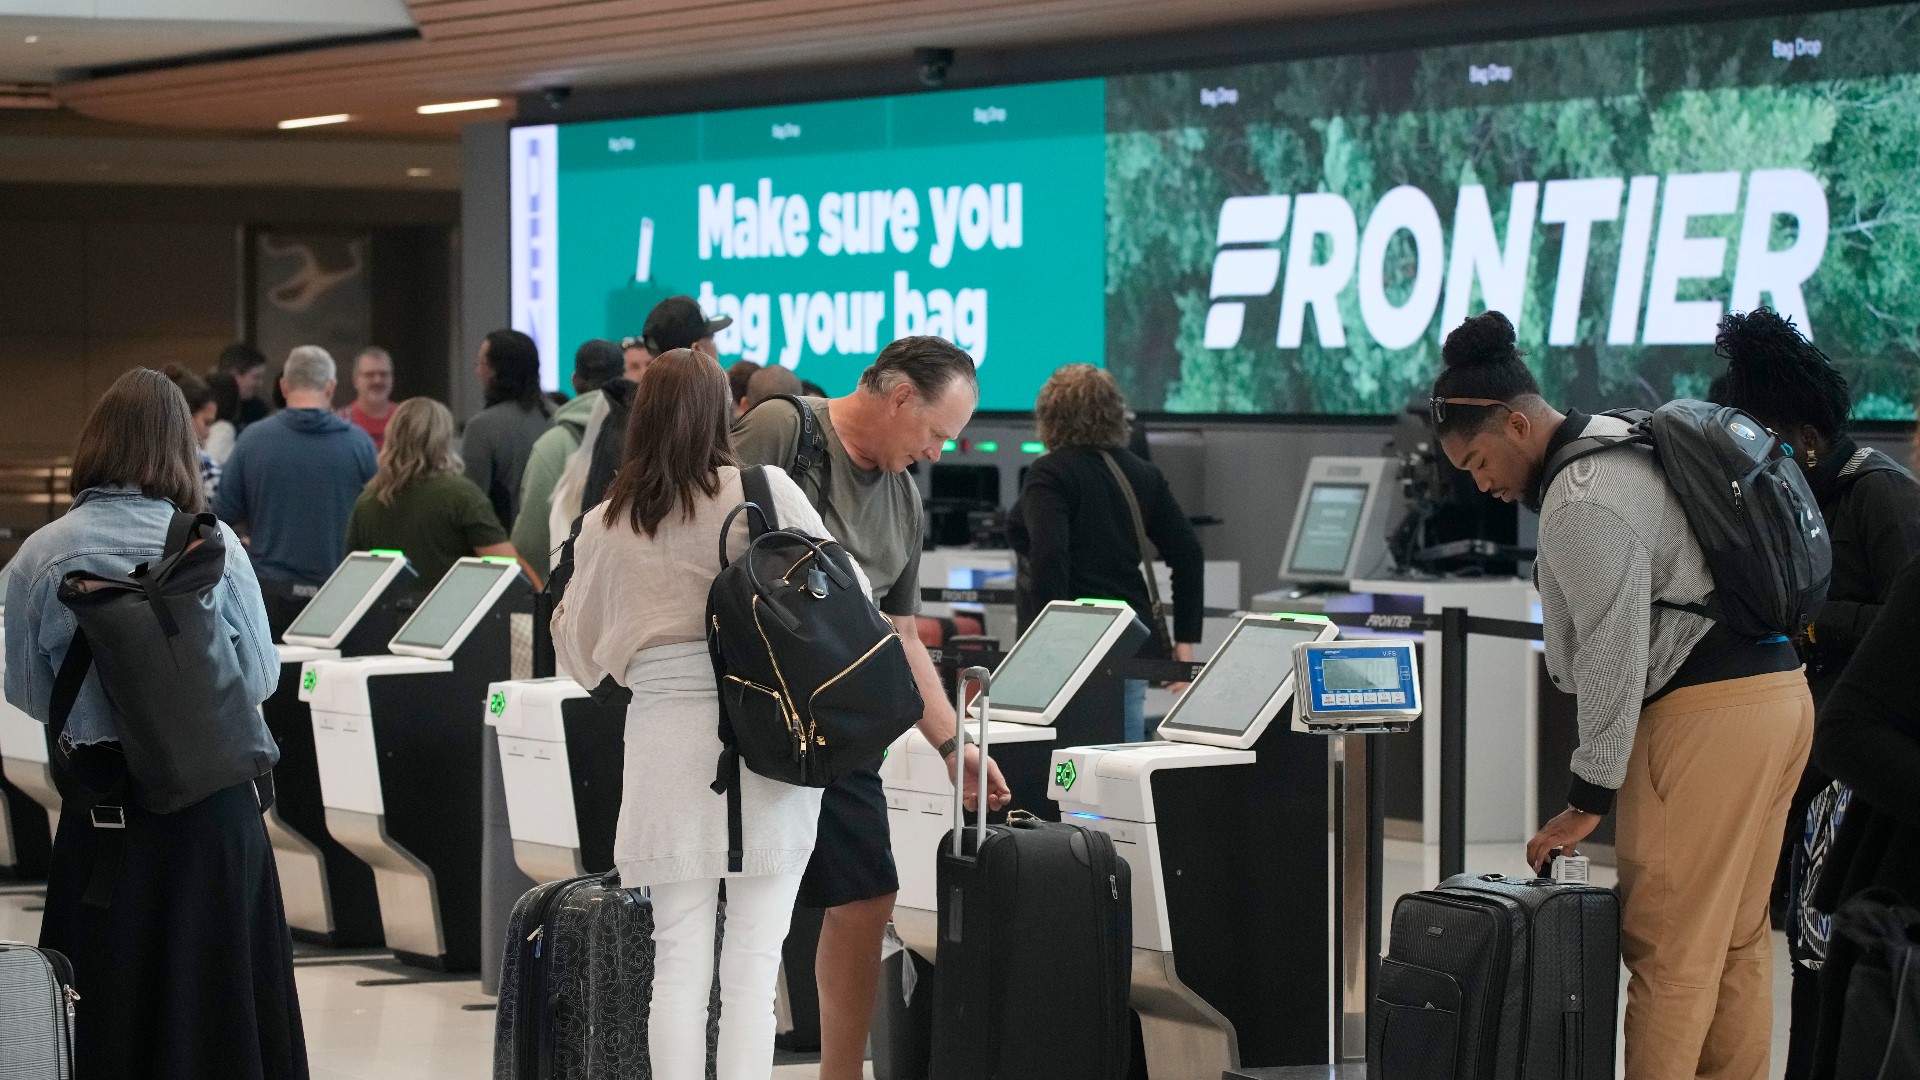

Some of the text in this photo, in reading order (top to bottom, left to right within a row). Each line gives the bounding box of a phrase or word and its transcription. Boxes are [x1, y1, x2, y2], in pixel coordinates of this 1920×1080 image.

[1772, 38, 1822, 61] Bag Drop
[699, 178, 1023, 268] Make sure you
[1203, 168, 1829, 350] FRONTIER
[779, 290, 885, 371] your
[894, 271, 988, 370] bag
[1365, 614, 1412, 628] FRONTIER
